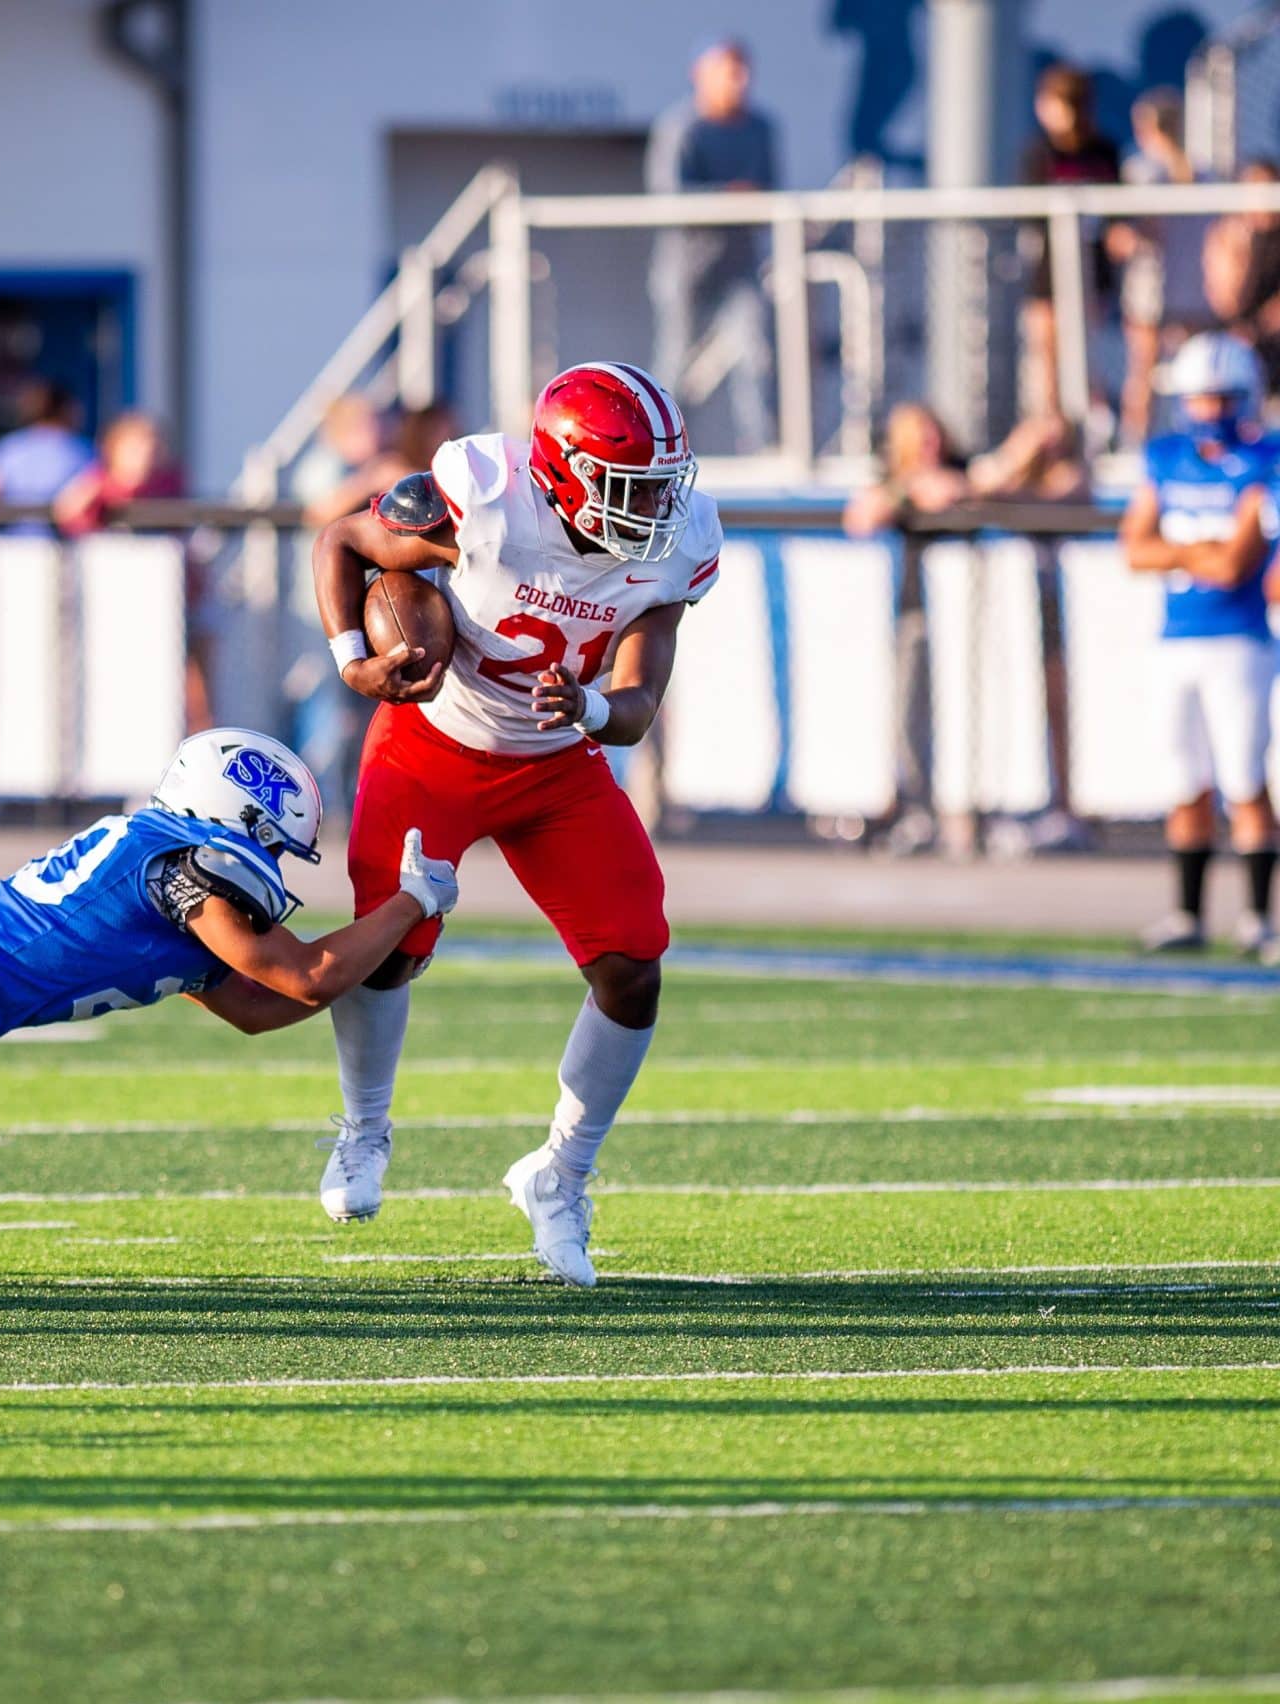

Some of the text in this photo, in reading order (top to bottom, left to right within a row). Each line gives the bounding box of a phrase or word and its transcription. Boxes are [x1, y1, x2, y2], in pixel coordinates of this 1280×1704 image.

[514, 583, 617, 622] COLONELS
[477, 612, 614, 693] 21
[223, 748, 303, 820] SK
